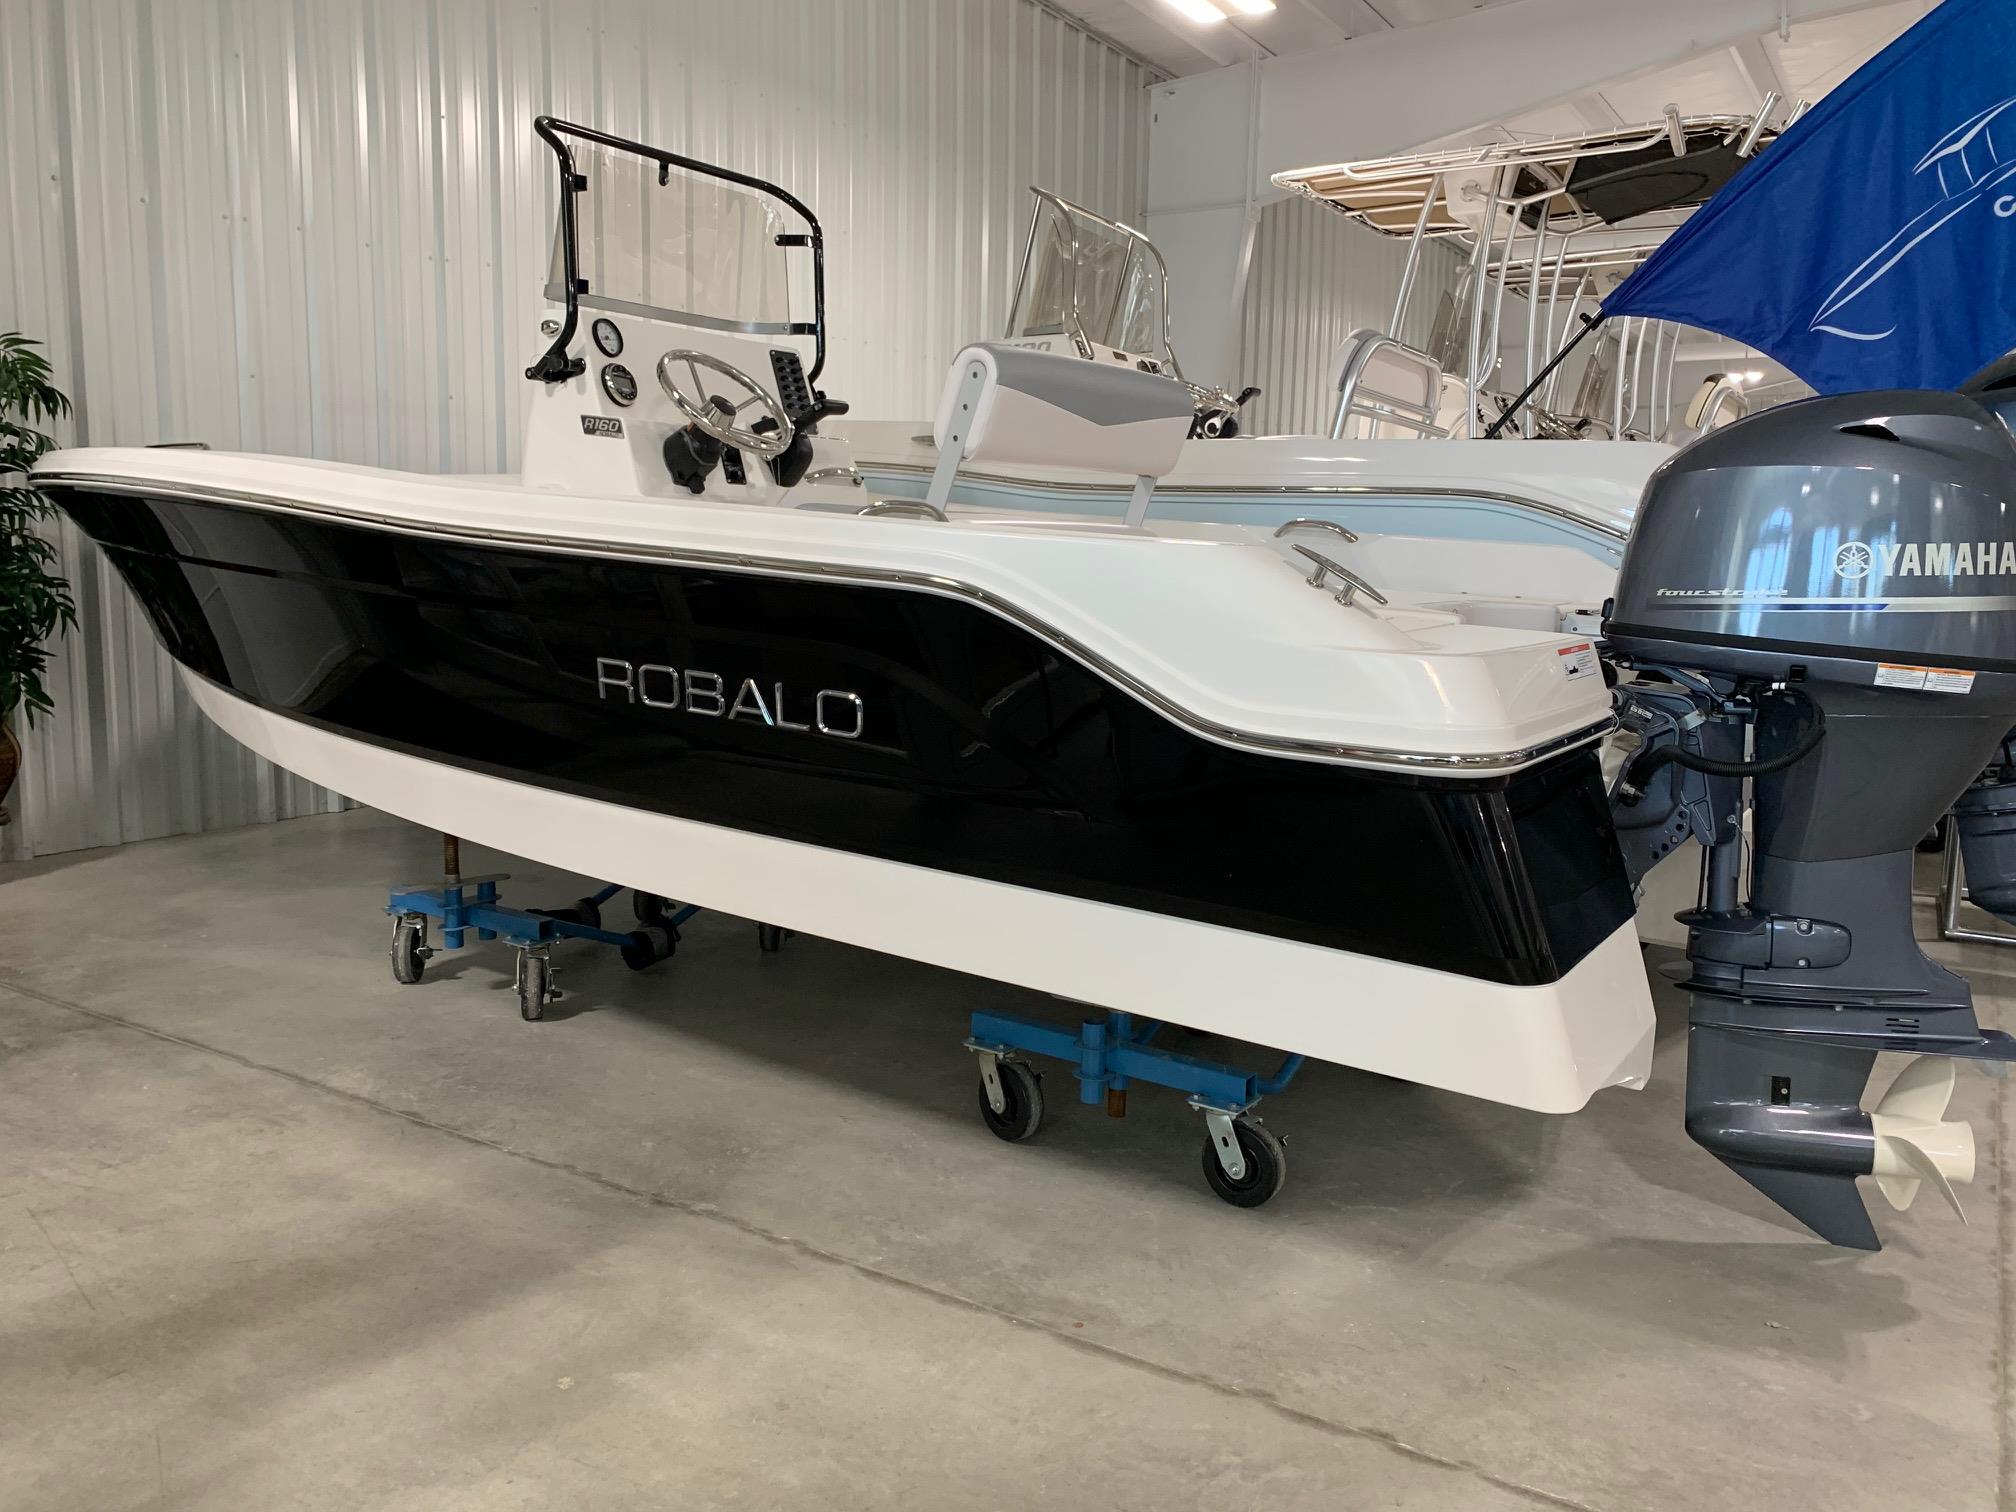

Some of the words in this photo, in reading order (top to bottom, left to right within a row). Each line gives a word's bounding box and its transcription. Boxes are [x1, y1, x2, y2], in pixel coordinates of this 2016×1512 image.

[584, 418, 620, 431] R160
[1879, 542, 2016, 576] YAMAHA
[597, 657, 863, 738] ROBALO
